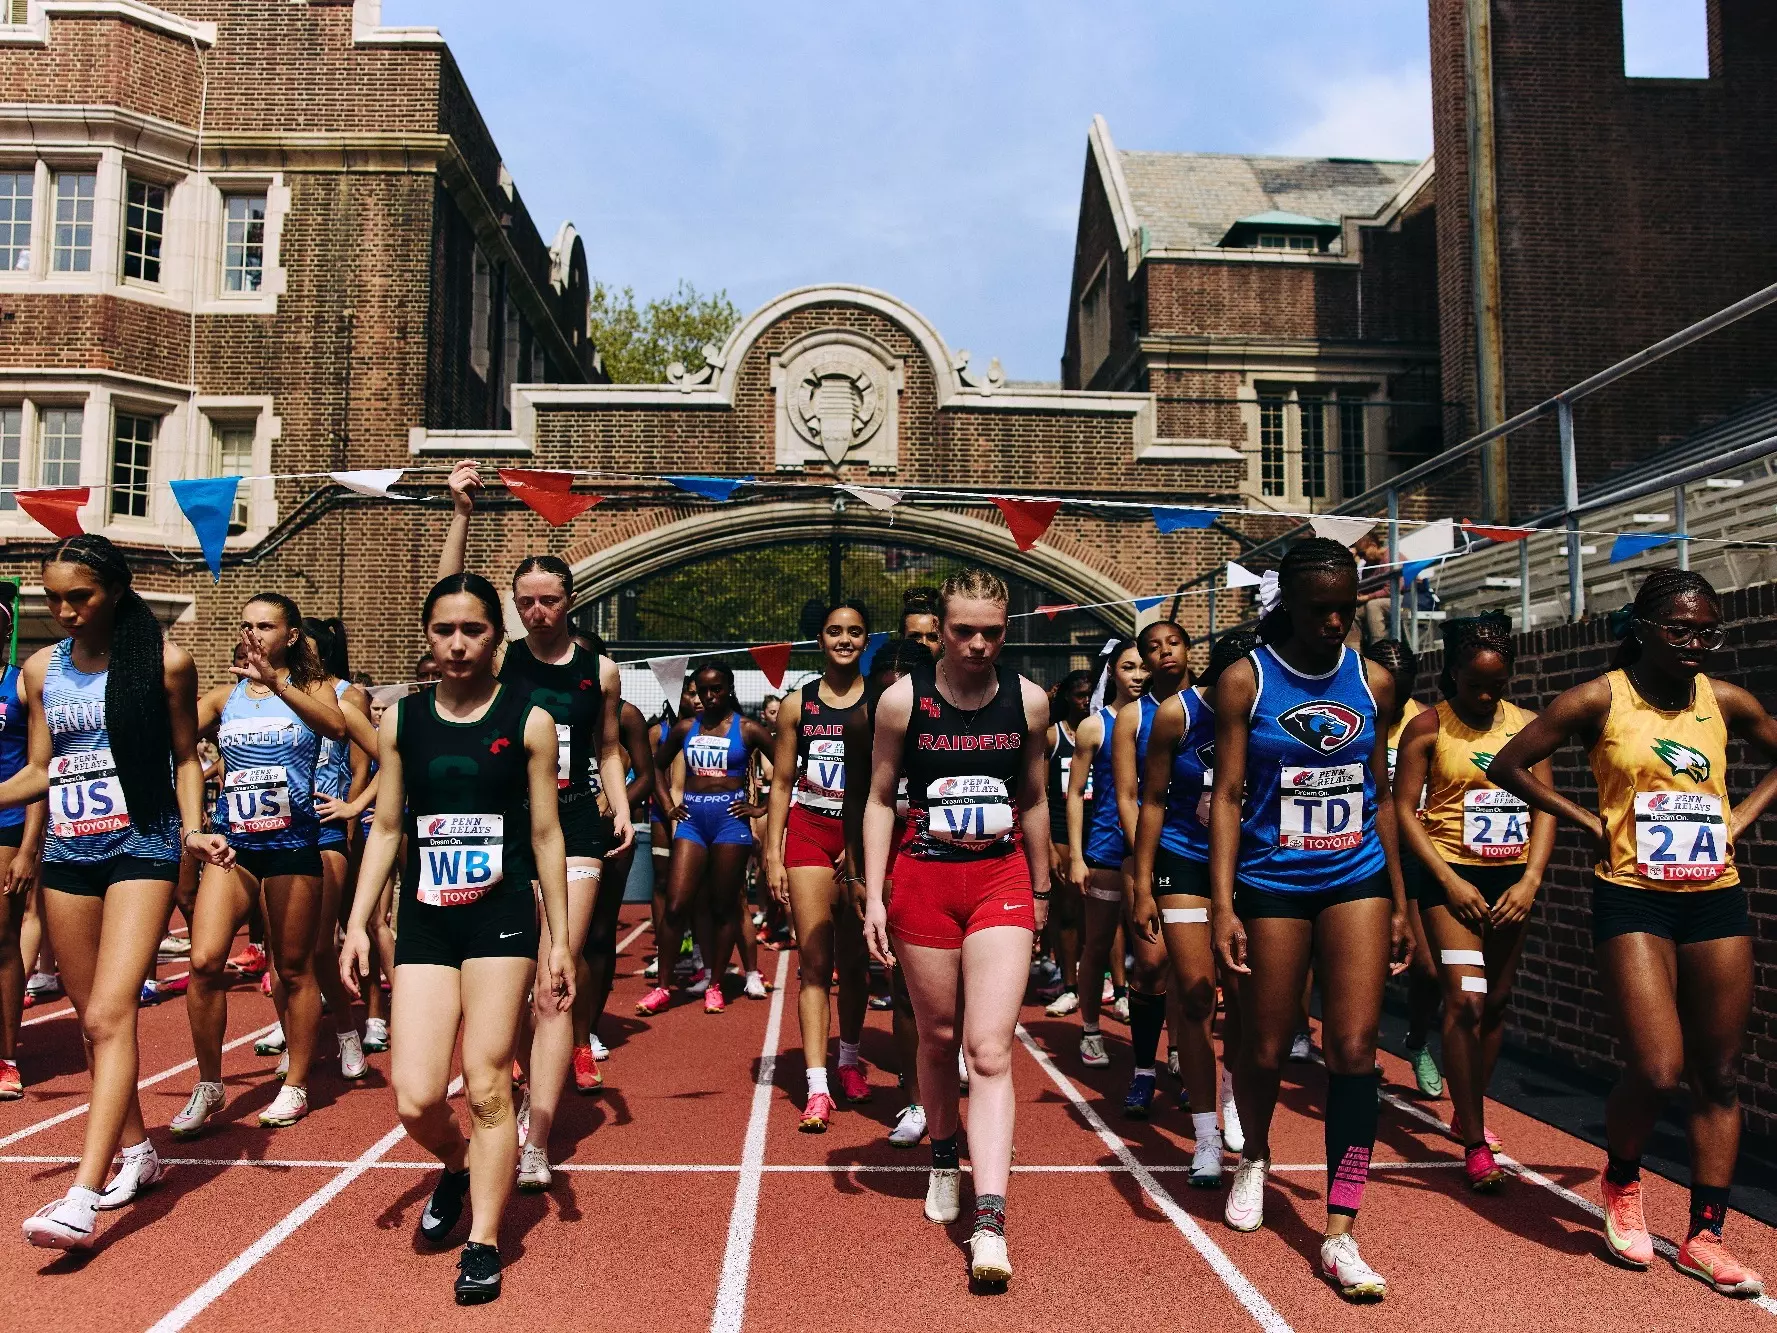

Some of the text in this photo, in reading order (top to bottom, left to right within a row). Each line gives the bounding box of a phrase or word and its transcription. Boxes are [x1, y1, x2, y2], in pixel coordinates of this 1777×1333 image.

[917, 732, 1021, 751] RAIDERS
[74, 753, 98, 763] PENN
[691, 749, 723, 769] NM
[73, 759, 108, 772] RELAYS
[1318, 768, 1347, 779] PENN
[962, 778, 990, 786] PENN
[1316, 774, 1354, 787] RELAYS
[961, 785, 999, 794] RELAYS
[61, 780, 114, 820] US
[703, 794, 731, 803] PRO
[1674, 794, 1703, 803] PENN
[235, 790, 281, 820] US
[1673, 802, 1711, 812] RELAYS
[451, 817, 482, 826] PENN
[1293, 798, 1351, 835] TD
[75, 816, 122, 834] TOYOTA
[248, 819, 286, 830] TOYOTA
[943, 807, 997, 841] VL
[449, 826, 492, 834] RELAYS
[430, 837, 463, 846] Dream On.
[1307, 835, 1357, 850] TOYOTA
[1484, 846, 1522, 856] TOYOTA
[428, 850, 492, 886] WB
[1666, 867, 1718, 878] TOYOTA
[443, 889, 487, 902] TOYOT
